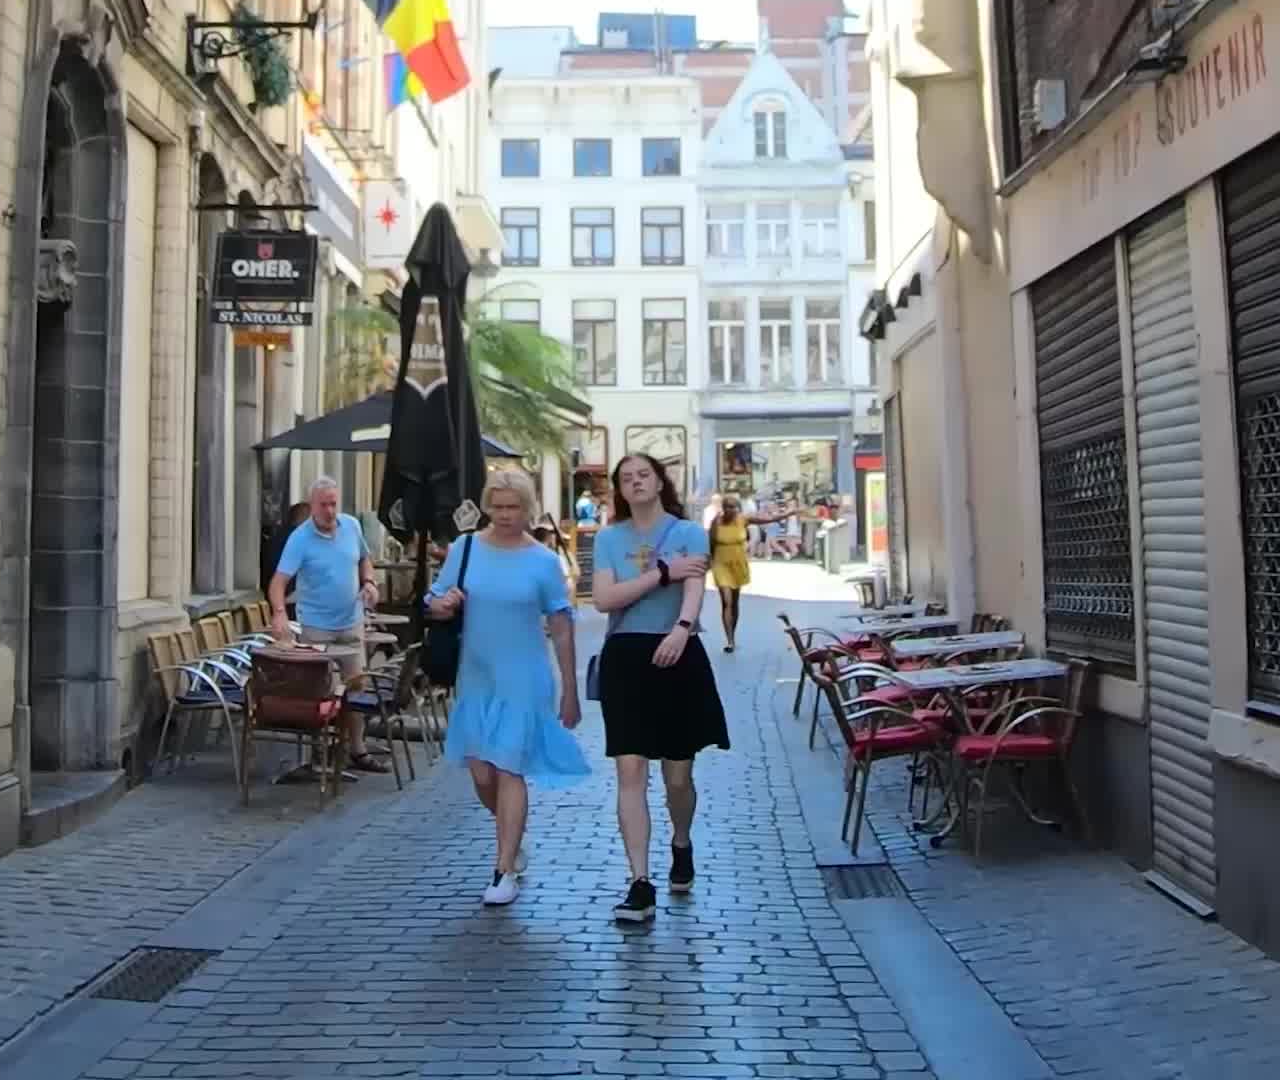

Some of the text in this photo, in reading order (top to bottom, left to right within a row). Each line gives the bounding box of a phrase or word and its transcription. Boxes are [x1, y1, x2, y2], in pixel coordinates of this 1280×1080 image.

[231, 259, 300, 279] OMER.
[218, 311, 304, 324] ST. NICOLAS
